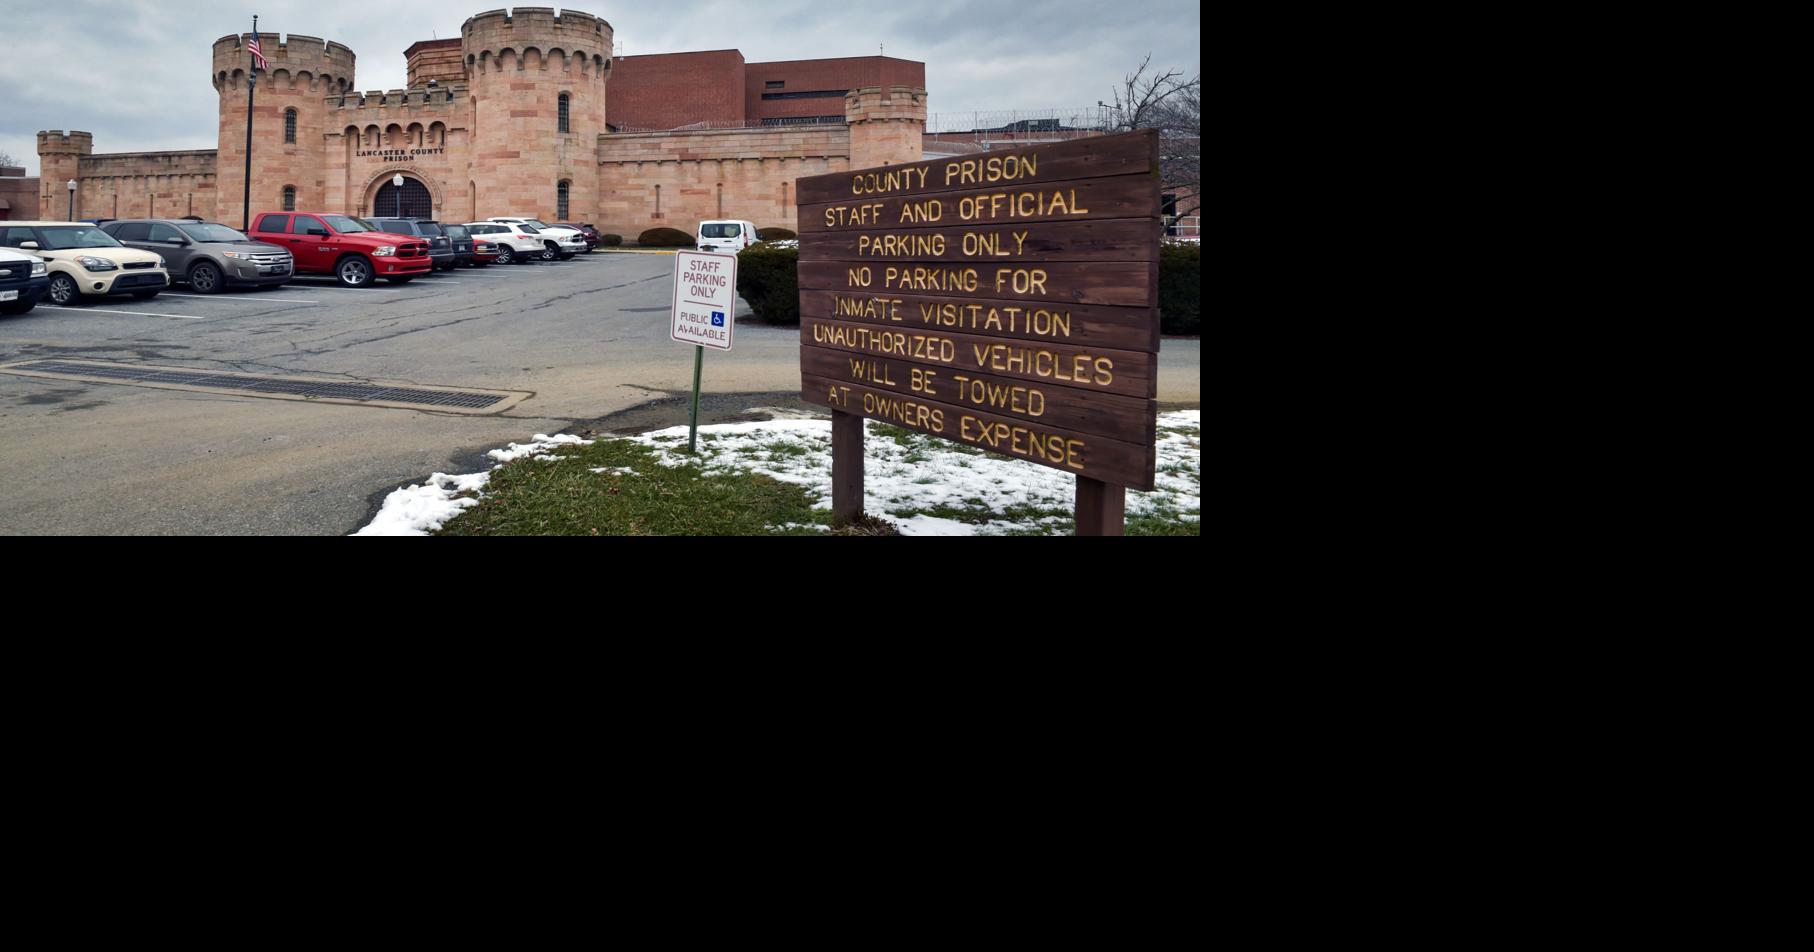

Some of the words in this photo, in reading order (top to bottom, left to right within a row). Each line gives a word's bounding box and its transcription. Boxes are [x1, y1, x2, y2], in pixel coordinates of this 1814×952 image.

[852, 167, 929, 195] COUNTY
[945, 153, 1038, 186] PRISON
[824, 204, 884, 228] STAFF
[900, 199, 942, 223] AND
[959, 189, 1089, 220] OFFICIAL
[858, 233, 945, 256] PARKING
[962, 231, 1028, 256] ONLY
[683, 272, 726, 287] PARKING
[690, 260, 720, 273] STAFF
[848, 266, 872, 287] NO
[886, 267, 978, 292] PARKING
[996, 269, 1047, 295] FOR
[690, 285, 716, 299] ONLY
[680, 312, 708, 324] PUBLIC
[834, 295, 903, 321] INMATE
[920, 302, 1071, 337] VISITATION
[678, 325, 726, 341] AVAILABLE
[813, 324, 955, 362] UNAUTHORIZED
[973, 343, 1114, 386] VEHICLES
[850, 359, 896, 387] WILL
[911, 368, 937, 395] BE
[953, 375, 1045, 417] TOWED
[828, 385, 851, 407] AT
[864, 392, 944, 432] OWNERS
[960, 415, 1085, 470] EXPENSE
